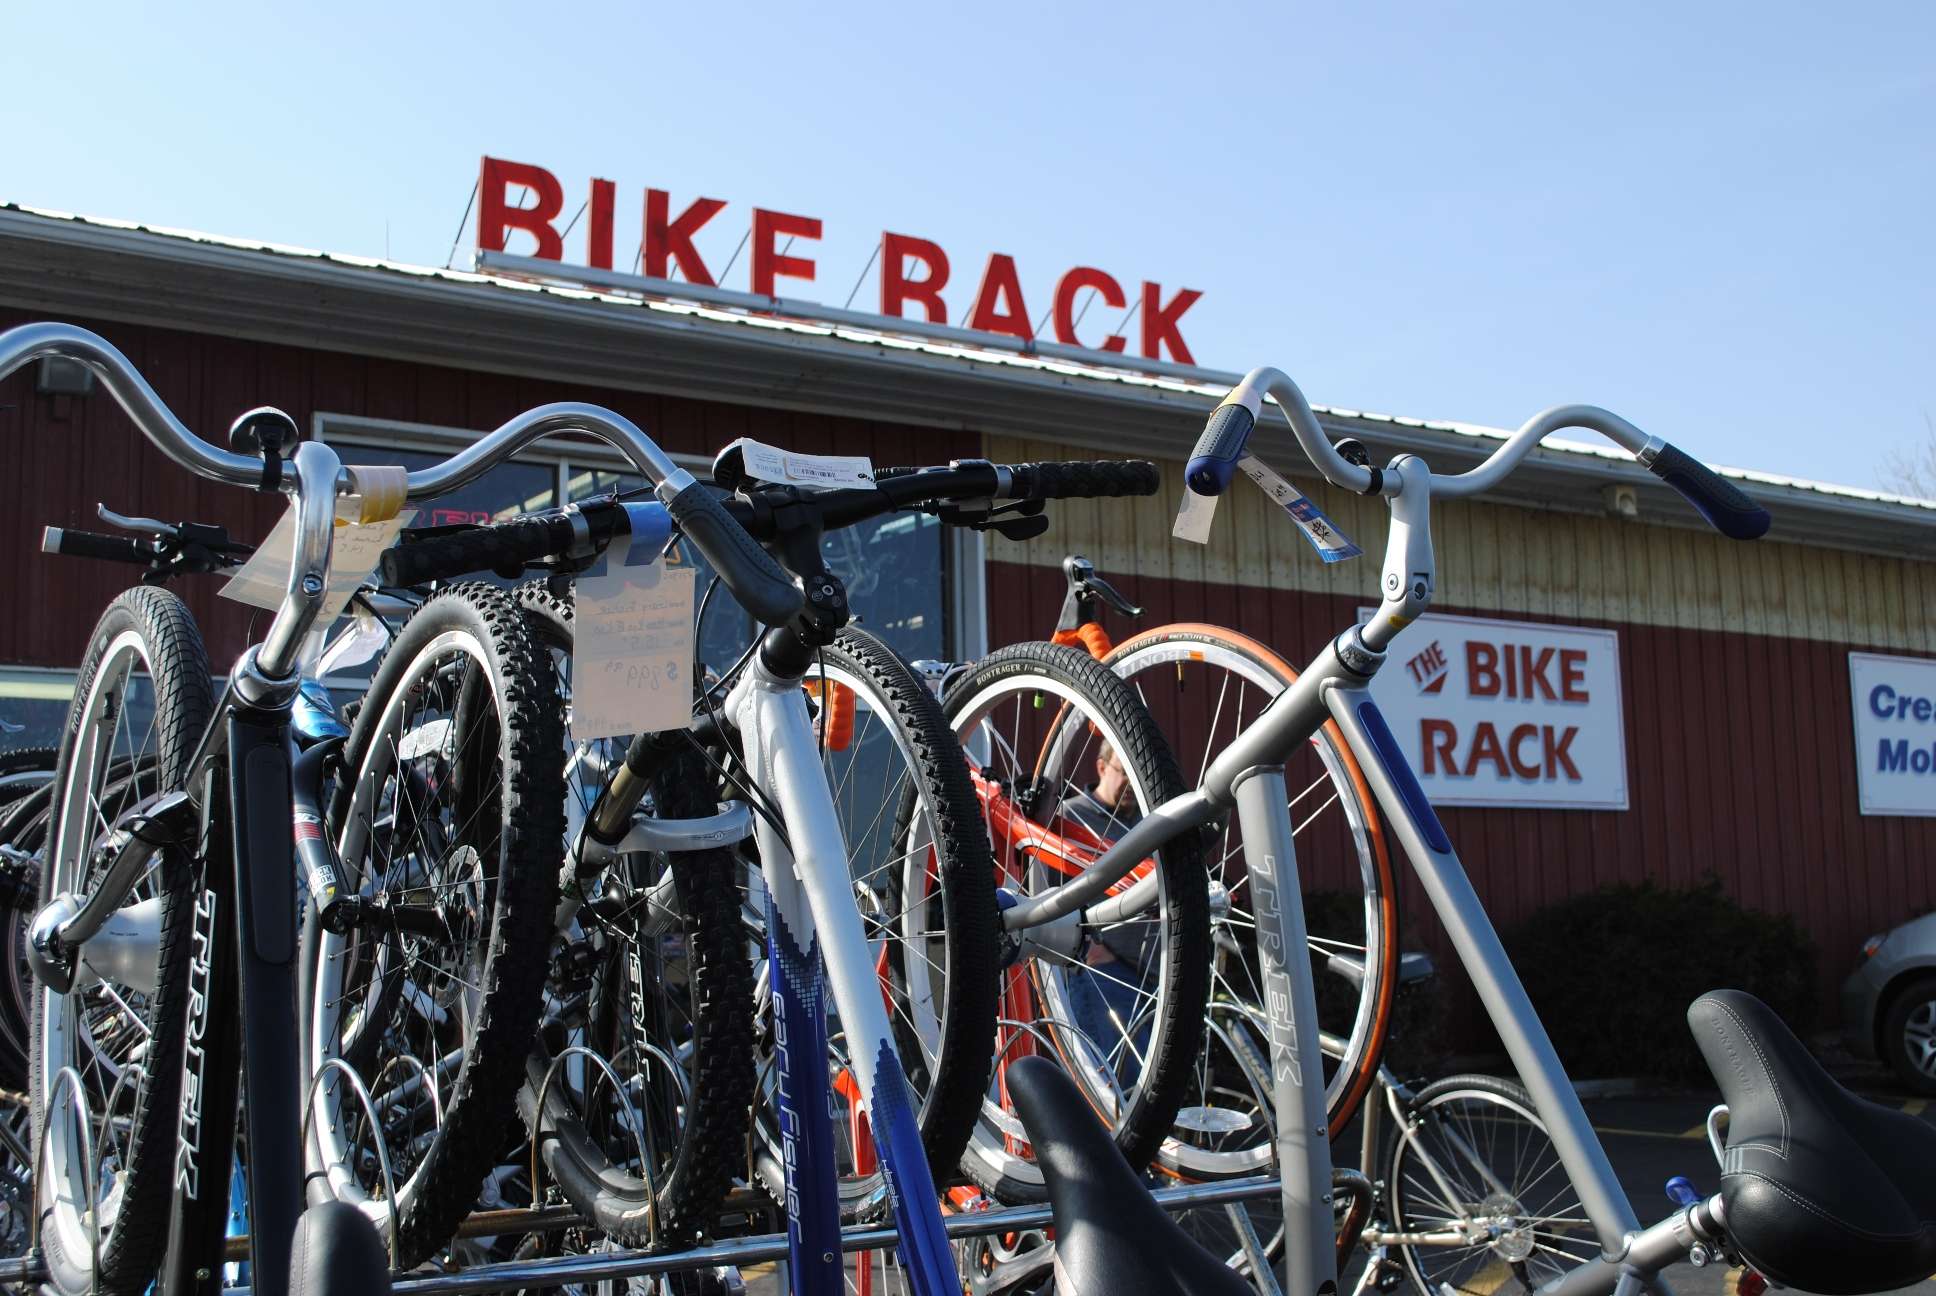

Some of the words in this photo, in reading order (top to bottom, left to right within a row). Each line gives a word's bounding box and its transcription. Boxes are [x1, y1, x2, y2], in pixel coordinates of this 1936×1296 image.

[476, 155, 822, 308] BIKE
[880, 230, 1204, 366] RACK
[71, 661, 98, 734] BONTRAGER
[976, 664, 1021, 687] BONTRAGER
[1405, 640, 1448, 684] THE
[1465, 640, 1589, 704] BIKE
[1869, 684, 1936, 721] Cre
[1420, 717, 1583, 782] RACK
[1251, 855, 1303, 1087] TREK
[174, 888, 217, 1200] TREK
